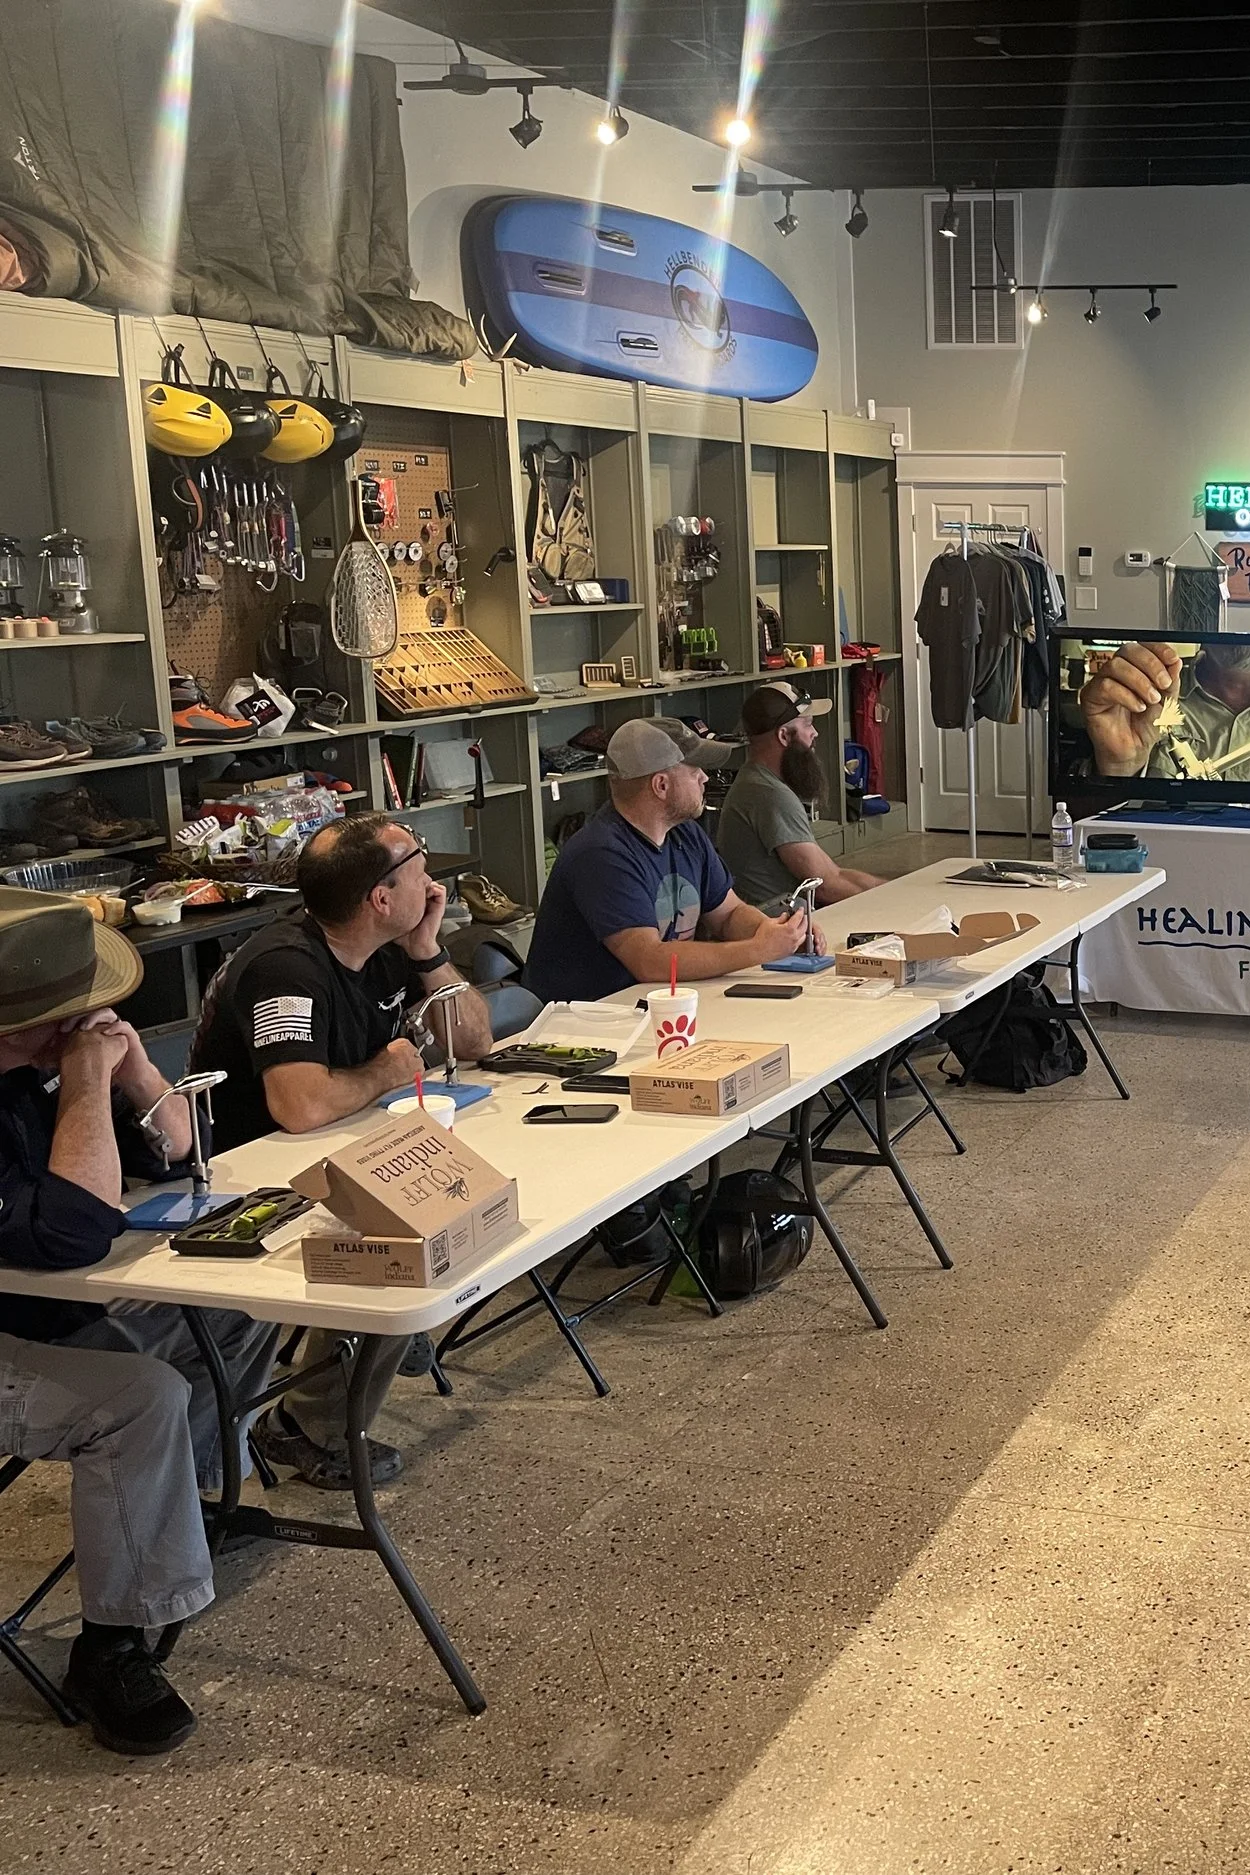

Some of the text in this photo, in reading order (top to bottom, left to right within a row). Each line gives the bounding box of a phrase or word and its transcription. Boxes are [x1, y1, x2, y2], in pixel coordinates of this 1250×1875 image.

[663, 250, 721, 288] HELLBEND
[653, 1079, 694, 1090] ATLAS VISE
[370, 1135, 453, 1183] indiana
[400, 1156, 474, 1207] WOLFF
[333, 1243, 390, 1255] ATLAS VISE
